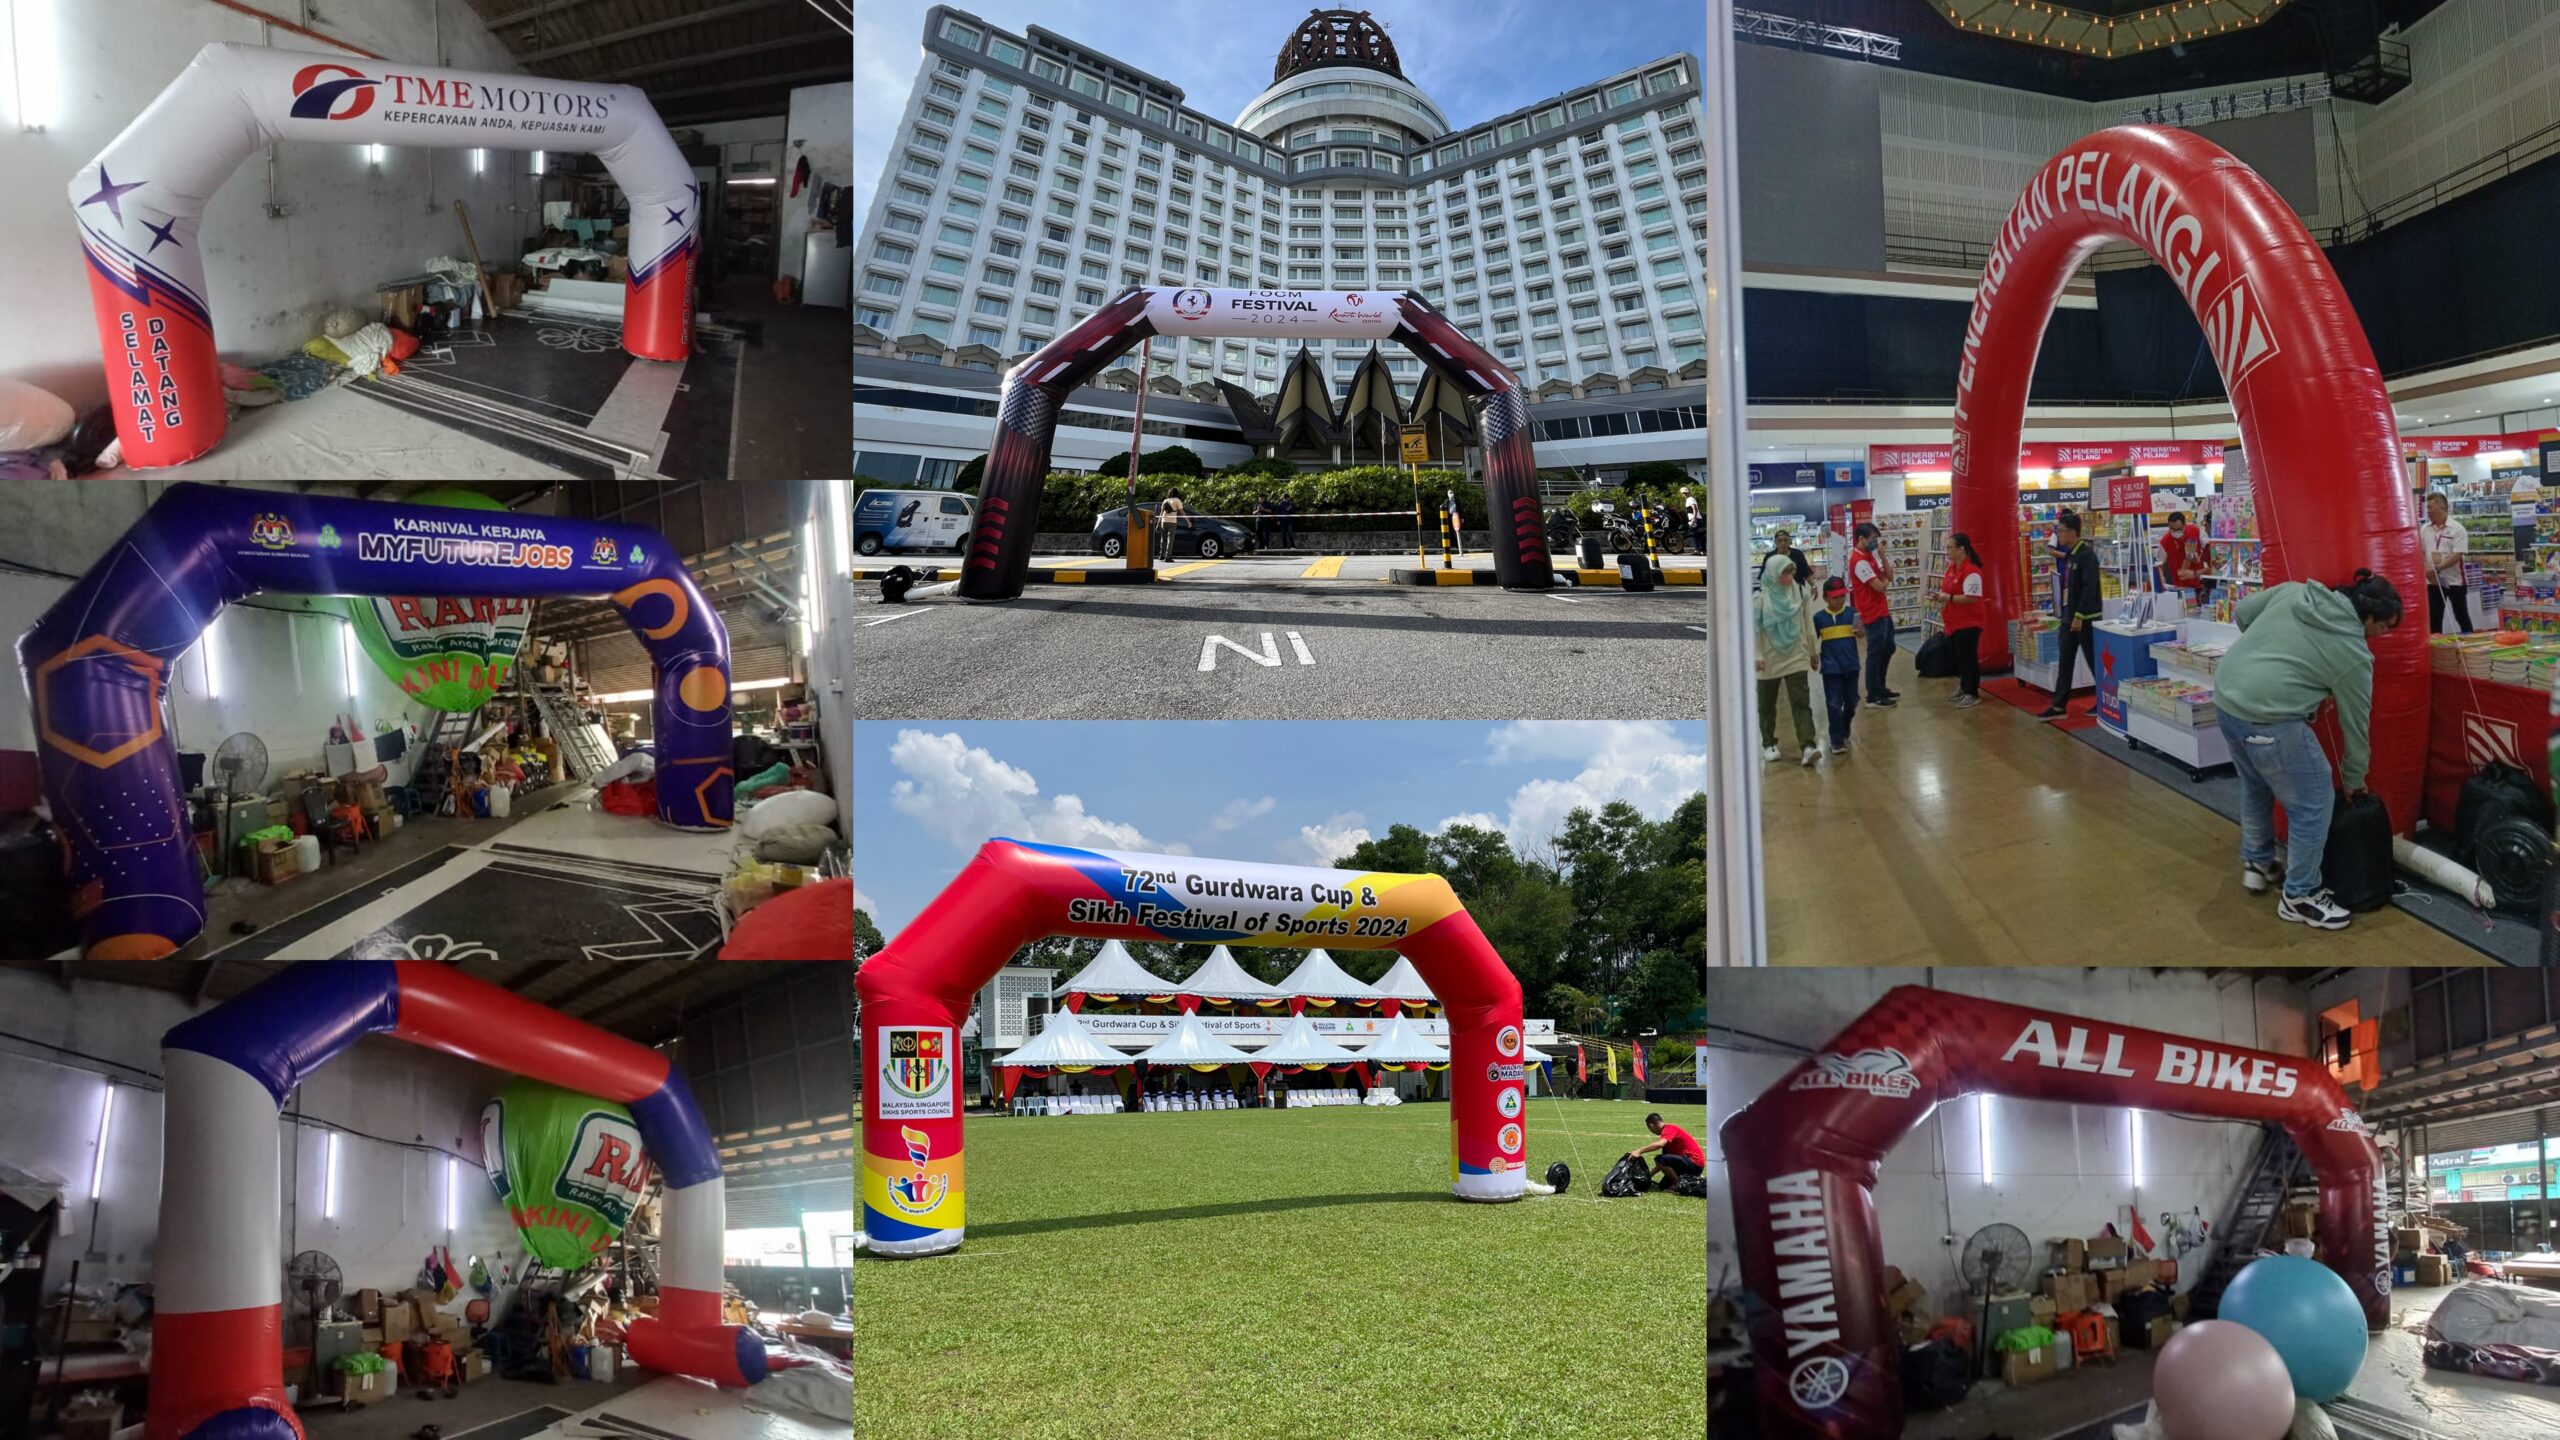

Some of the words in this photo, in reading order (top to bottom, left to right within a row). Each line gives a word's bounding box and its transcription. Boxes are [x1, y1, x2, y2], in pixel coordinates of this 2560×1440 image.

[385, 74, 475, 109] TME
[384, 110, 477, 127] KEPERCAYAAN
[481, 117, 516, 131] ANDA,
[520, 120, 577, 134] KEPUASAN
[580, 123, 606, 135] KAMI
[2056, 151, 2221, 314] PELANGI
[1231, 299, 1318, 312] FESTIVAL
[1250, 314, 1298, 324] 2024
[120, 312, 155, 443] SELAMAT
[148, 318, 182, 427] DATANG
[1919, 499, 1937, 507] 20%
[2076, 491, 2089, 499] OFF
[394, 518, 478, 537] KARNIVAL
[481, 525, 546, 541] KERJAYA
[358, 532, 573, 569] MYFUTUREJOBS
[1121, 868, 1176, 894] 72nd
[1185, 874, 1303, 903] Gurdwara
[1310, 883, 1353, 910] Cup
[1361, 886, 1377, 907] &
[1069, 899, 1129, 925] Sikh
[1137, 904, 1237, 931] Festival
[1248, 912, 1268, 932] of
[1275, 913, 1349, 937] Sports
[1354, 917, 1409, 938] 2024
[1092, 1019, 1137, 1028] Gurdwara
[1139, 1021, 1158, 1029] Cup
[1234, 1021, 1261, 1030] Sports
[2001, 1019, 2135, 1078] ALL
[2155, 1043, 2298, 1098] BIKES
[1845, 1072, 1911, 1089] BIKES
[2432, 1156, 2464, 1166] Astral
[2372, 1179, 2390, 1269] YAMAHA
[1766, 1169, 1841, 1358] YAMAHA
